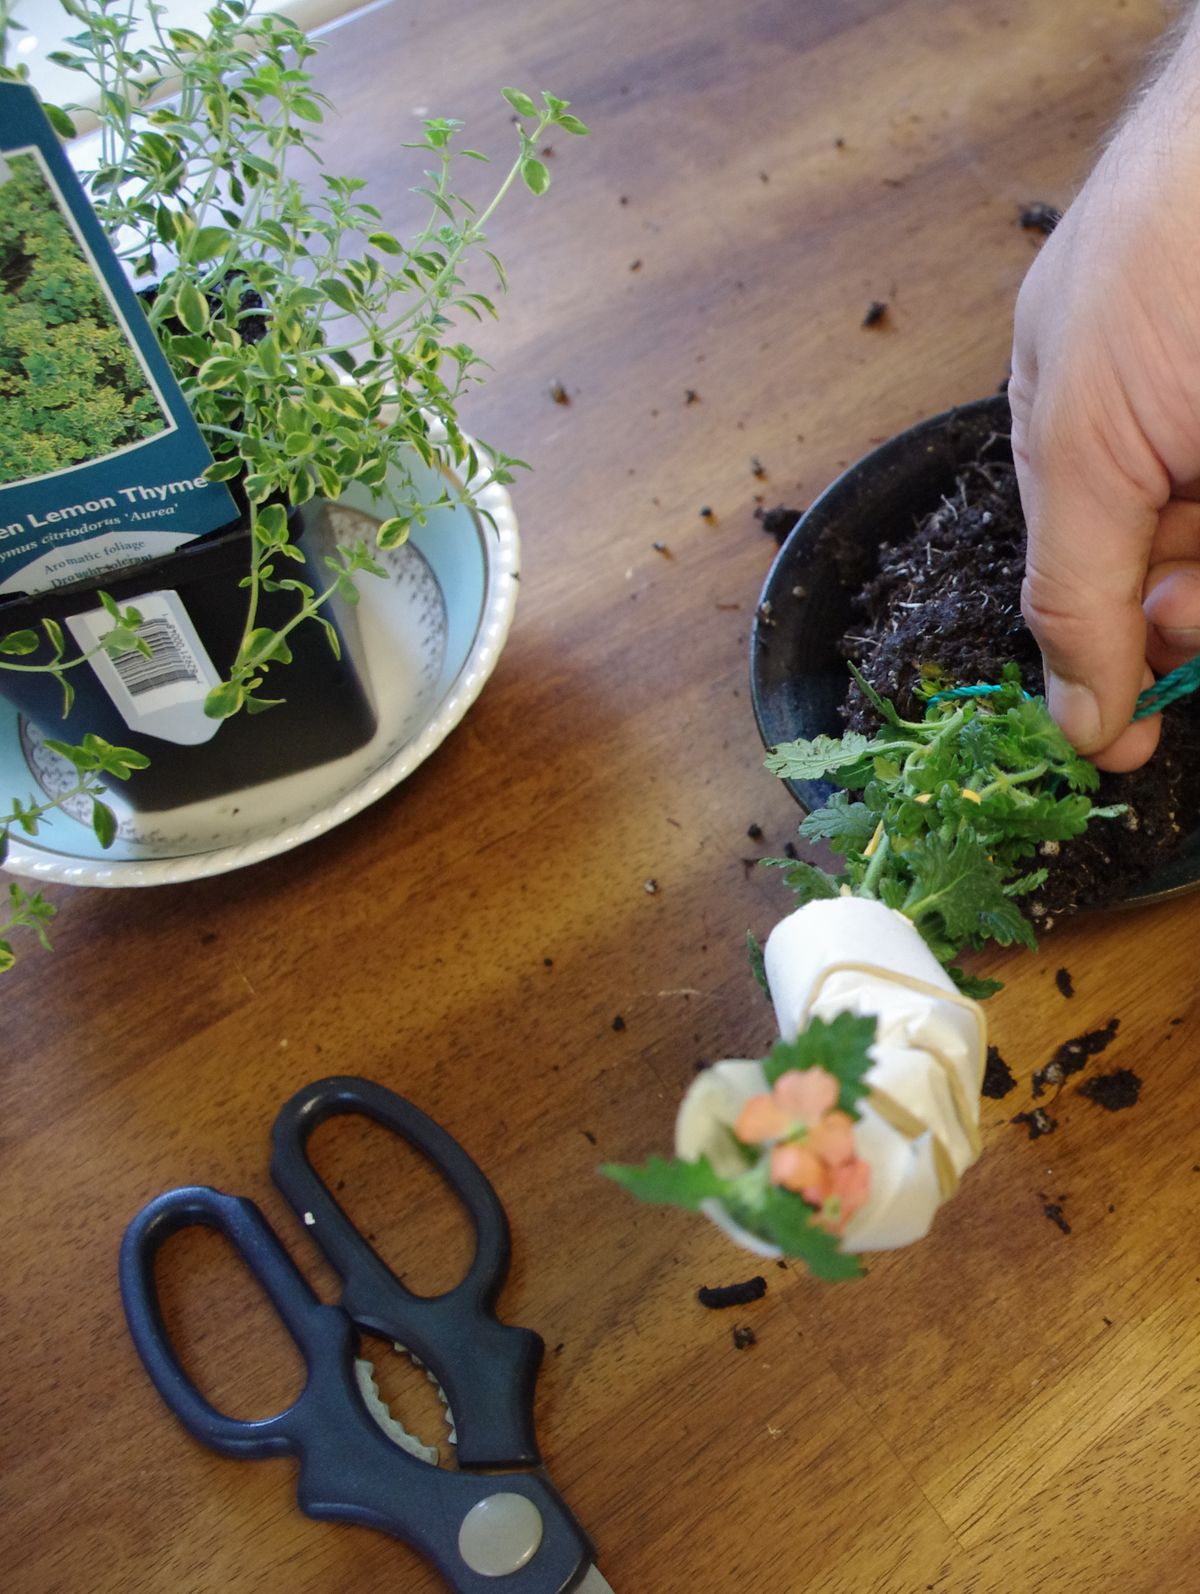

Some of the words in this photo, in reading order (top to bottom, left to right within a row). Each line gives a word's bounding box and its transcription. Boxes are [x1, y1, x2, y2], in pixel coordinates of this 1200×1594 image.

[26, 493, 117, 528] Lemon
[118, 475, 209, 505] Thyme
[41, 516, 121, 544] citriodorus
[44, 551, 102, 575] Aromatic
[103, 539, 146, 556] foliage
